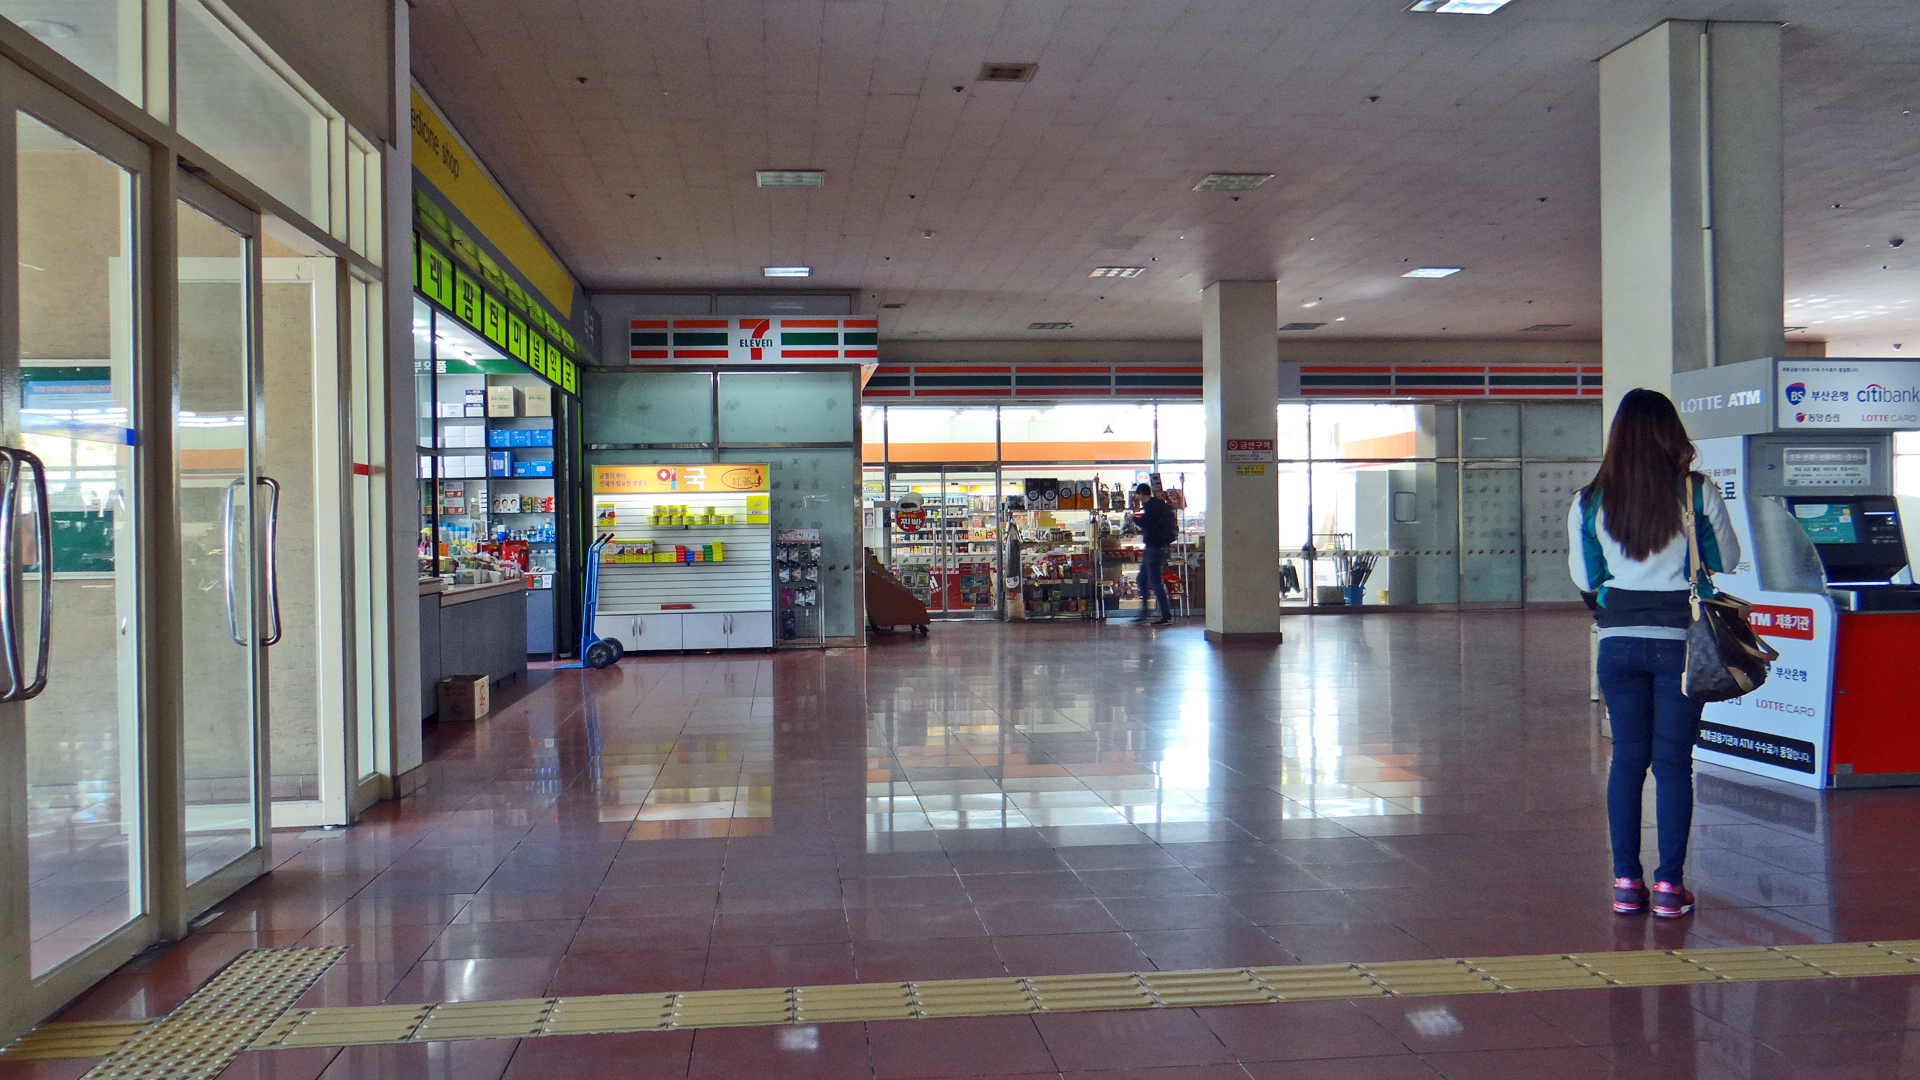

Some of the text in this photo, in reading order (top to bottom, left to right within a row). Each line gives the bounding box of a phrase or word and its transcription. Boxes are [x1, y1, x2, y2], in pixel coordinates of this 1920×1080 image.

[411, 106, 460, 182] edicine shop
[1680, 388, 1762, 415] LOTTE ATM
[1790, 390, 1804, 402] BS
[1810, 390, 1849, 402] 부산은행
[1856, 384, 1920, 403] citibank
[1808, 413, 1840, 423] 동양증권
[1240, 441, 1271, 450] 금연구역
[656, 467, 707, 491] 약국
[900, 517, 923, 530] 찐빵
[1749, 612, 1810, 631] TM 제휴기관
[1776, 666, 1807, 683] 부산은행
[1739, 738, 1754, 750] ATM
[1754, 741, 1779, 756] 수수료가
